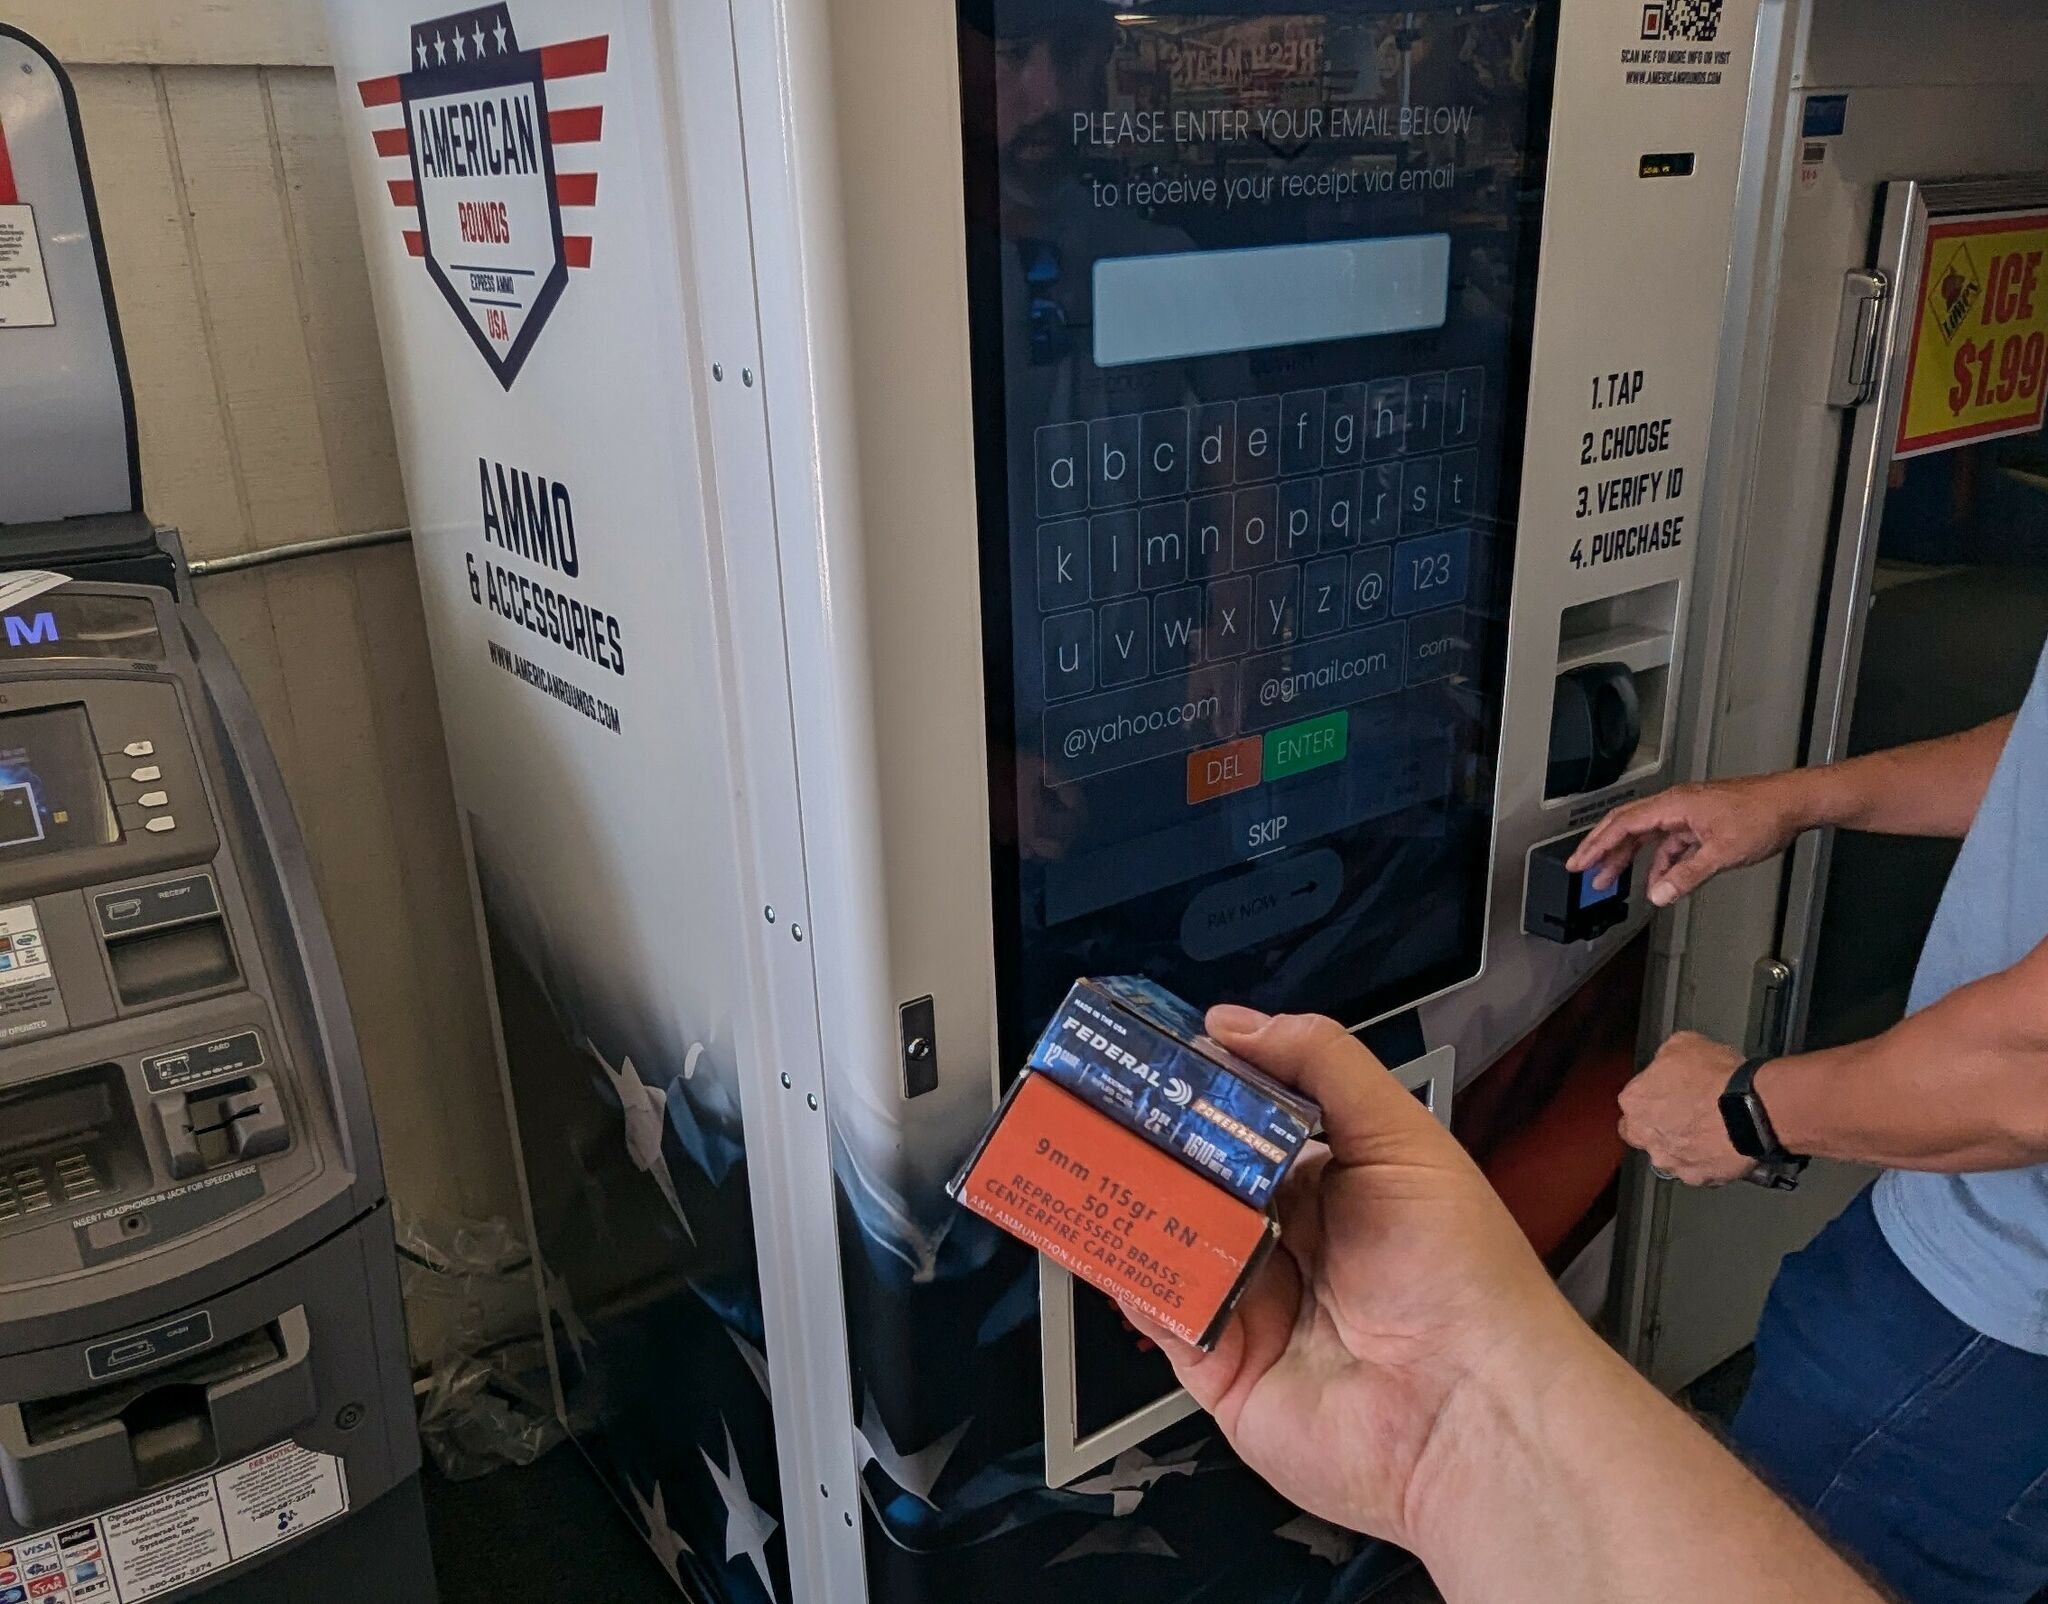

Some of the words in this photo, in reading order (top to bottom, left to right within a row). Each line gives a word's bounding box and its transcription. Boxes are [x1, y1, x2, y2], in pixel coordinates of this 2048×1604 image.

[1621, 49, 1640, 64] SCAN
[1640, 49, 1652, 64] ME
[1667, 50, 1686, 64] MORE
[1714, 51, 1731, 64] VISIT
[418, 95, 538, 178] AMERICAN
[1073, 111, 1165, 145] PLEASE
[1175, 110, 1249, 142] ENTER
[1257, 108, 1323, 139] YOUR
[1330, 107, 1391, 138] EMAIL
[1400, 105, 1474, 135] BELOW
[1092, 179, 1118, 207] to
[1127, 173, 1217, 205] receive
[1224, 176, 1274, 210] your
[1281, 167, 1358, 202] receipt
[1365, 166, 1393, 193] via
[1400, 162, 1455, 190] email
[458, 201, 510, 244] ROUNDS
[469, 273, 495, 293] EXPRESS
[1981, 251, 2043, 326] ICE
[487, 307, 509, 341] USA
[1949, 331, 2045, 417] $1.99
[1050, 457, 1074, 489] a
[1104, 442, 1126, 481] b
[1154, 443, 1174, 472] c
[1201, 425, 1222, 465] d
[1248, 428, 1267, 457] e
[1296, 412, 1308, 449] f
[1334, 415, 1354, 453] g
[1376, 399, 1393, 438] h
[1456, 389, 1467, 435] j
[1598, 471, 1663, 514] VERIFY
[1666, 467, 1683, 500] ID
[478, 457, 579, 578] AMMO
[1058, 545, 1072, 583] k
[1147, 533, 1180, 565] m
[1201, 526, 1219, 555] n
[1246, 517, 1265, 545] o
[1288, 509, 1308, 549] p
[1331, 500, 1349, 537] q
[1376, 492, 1386, 520] r
[1413, 486, 1427, 512] s
[1453, 473, 1462, 503] t
[4, 612, 60, 646] M
[466, 552, 481, 605] &
[485, 560, 625, 676] ACCESSORIES
[1059, 643, 1078, 672] u
[1115, 630, 1134, 659] v
[1164, 617, 1192, 648] w
[1221, 607, 1236, 636] x
[1269, 596, 1286, 635] y
[1317, 586, 1331, 613] z
[1356, 573, 1382, 610] @
[1412, 554, 1450, 591] 123
[488, 639, 622, 735] WWW.AMERICANROUNDS.COM
[1064, 695, 1220, 758] @yahoo.com
[1260, 652, 1387, 706] @gmail.com
[1207, 755, 1243, 786] DEL
[1277, 728, 1335, 765] ENTER
[1248, 815, 1288, 847] SKIP
[158, 886, 191, 899] RECEIPT
[208, 1042, 230, 1053] CARD
[1062, 1016, 1161, 1088] FEDERAL
[1113, 1022, 1127, 1036] USA
[1043, 1042, 1062, 1068] 12
[1182, 1132, 1216, 1166] 1610
[73, 1213, 101, 1229] INSERT
[103, 1197, 156, 1219] HEADPHONES
[167, 1186, 187, 1200] JACK
[187, 1182, 204, 1193] FOR
[204, 1172, 234, 1188] SPEECH
[234, 1165, 257, 1178] MODE
[1012, 1174, 1123, 1250] REPROCESSED
[1035, 1137, 1091, 1182] 9mm
[1099, 1175, 1157, 1221] 115gr
[1163, 1216, 1198, 1248] RN
[1082, 1194, 1109, 1220] 50
[1113, 1215, 1135, 1237] ct
[986, 1179, 1080, 1244] CENTERFIRE
[1084, 1240, 1184, 1309] CARTRIDGES
[996, 1210, 1069, 1261] AMMUNITION
[1096, 1273, 1157, 1317] LOUISIANA
[1159, 1312, 1193, 1339] MADE
[167, 1326, 189, 1337] CASH
[107, 1497, 164, 1522] Operational
[165, 1482, 209, 1501] Problems
[122, 1503, 173, 1527] Suspicious
[174, 1489, 210, 1507] Activity
[23, 1541, 53, 1556] VISA
[131, 1525, 176, 1546] Universal
[177, 1516, 200, 1528] Cash
